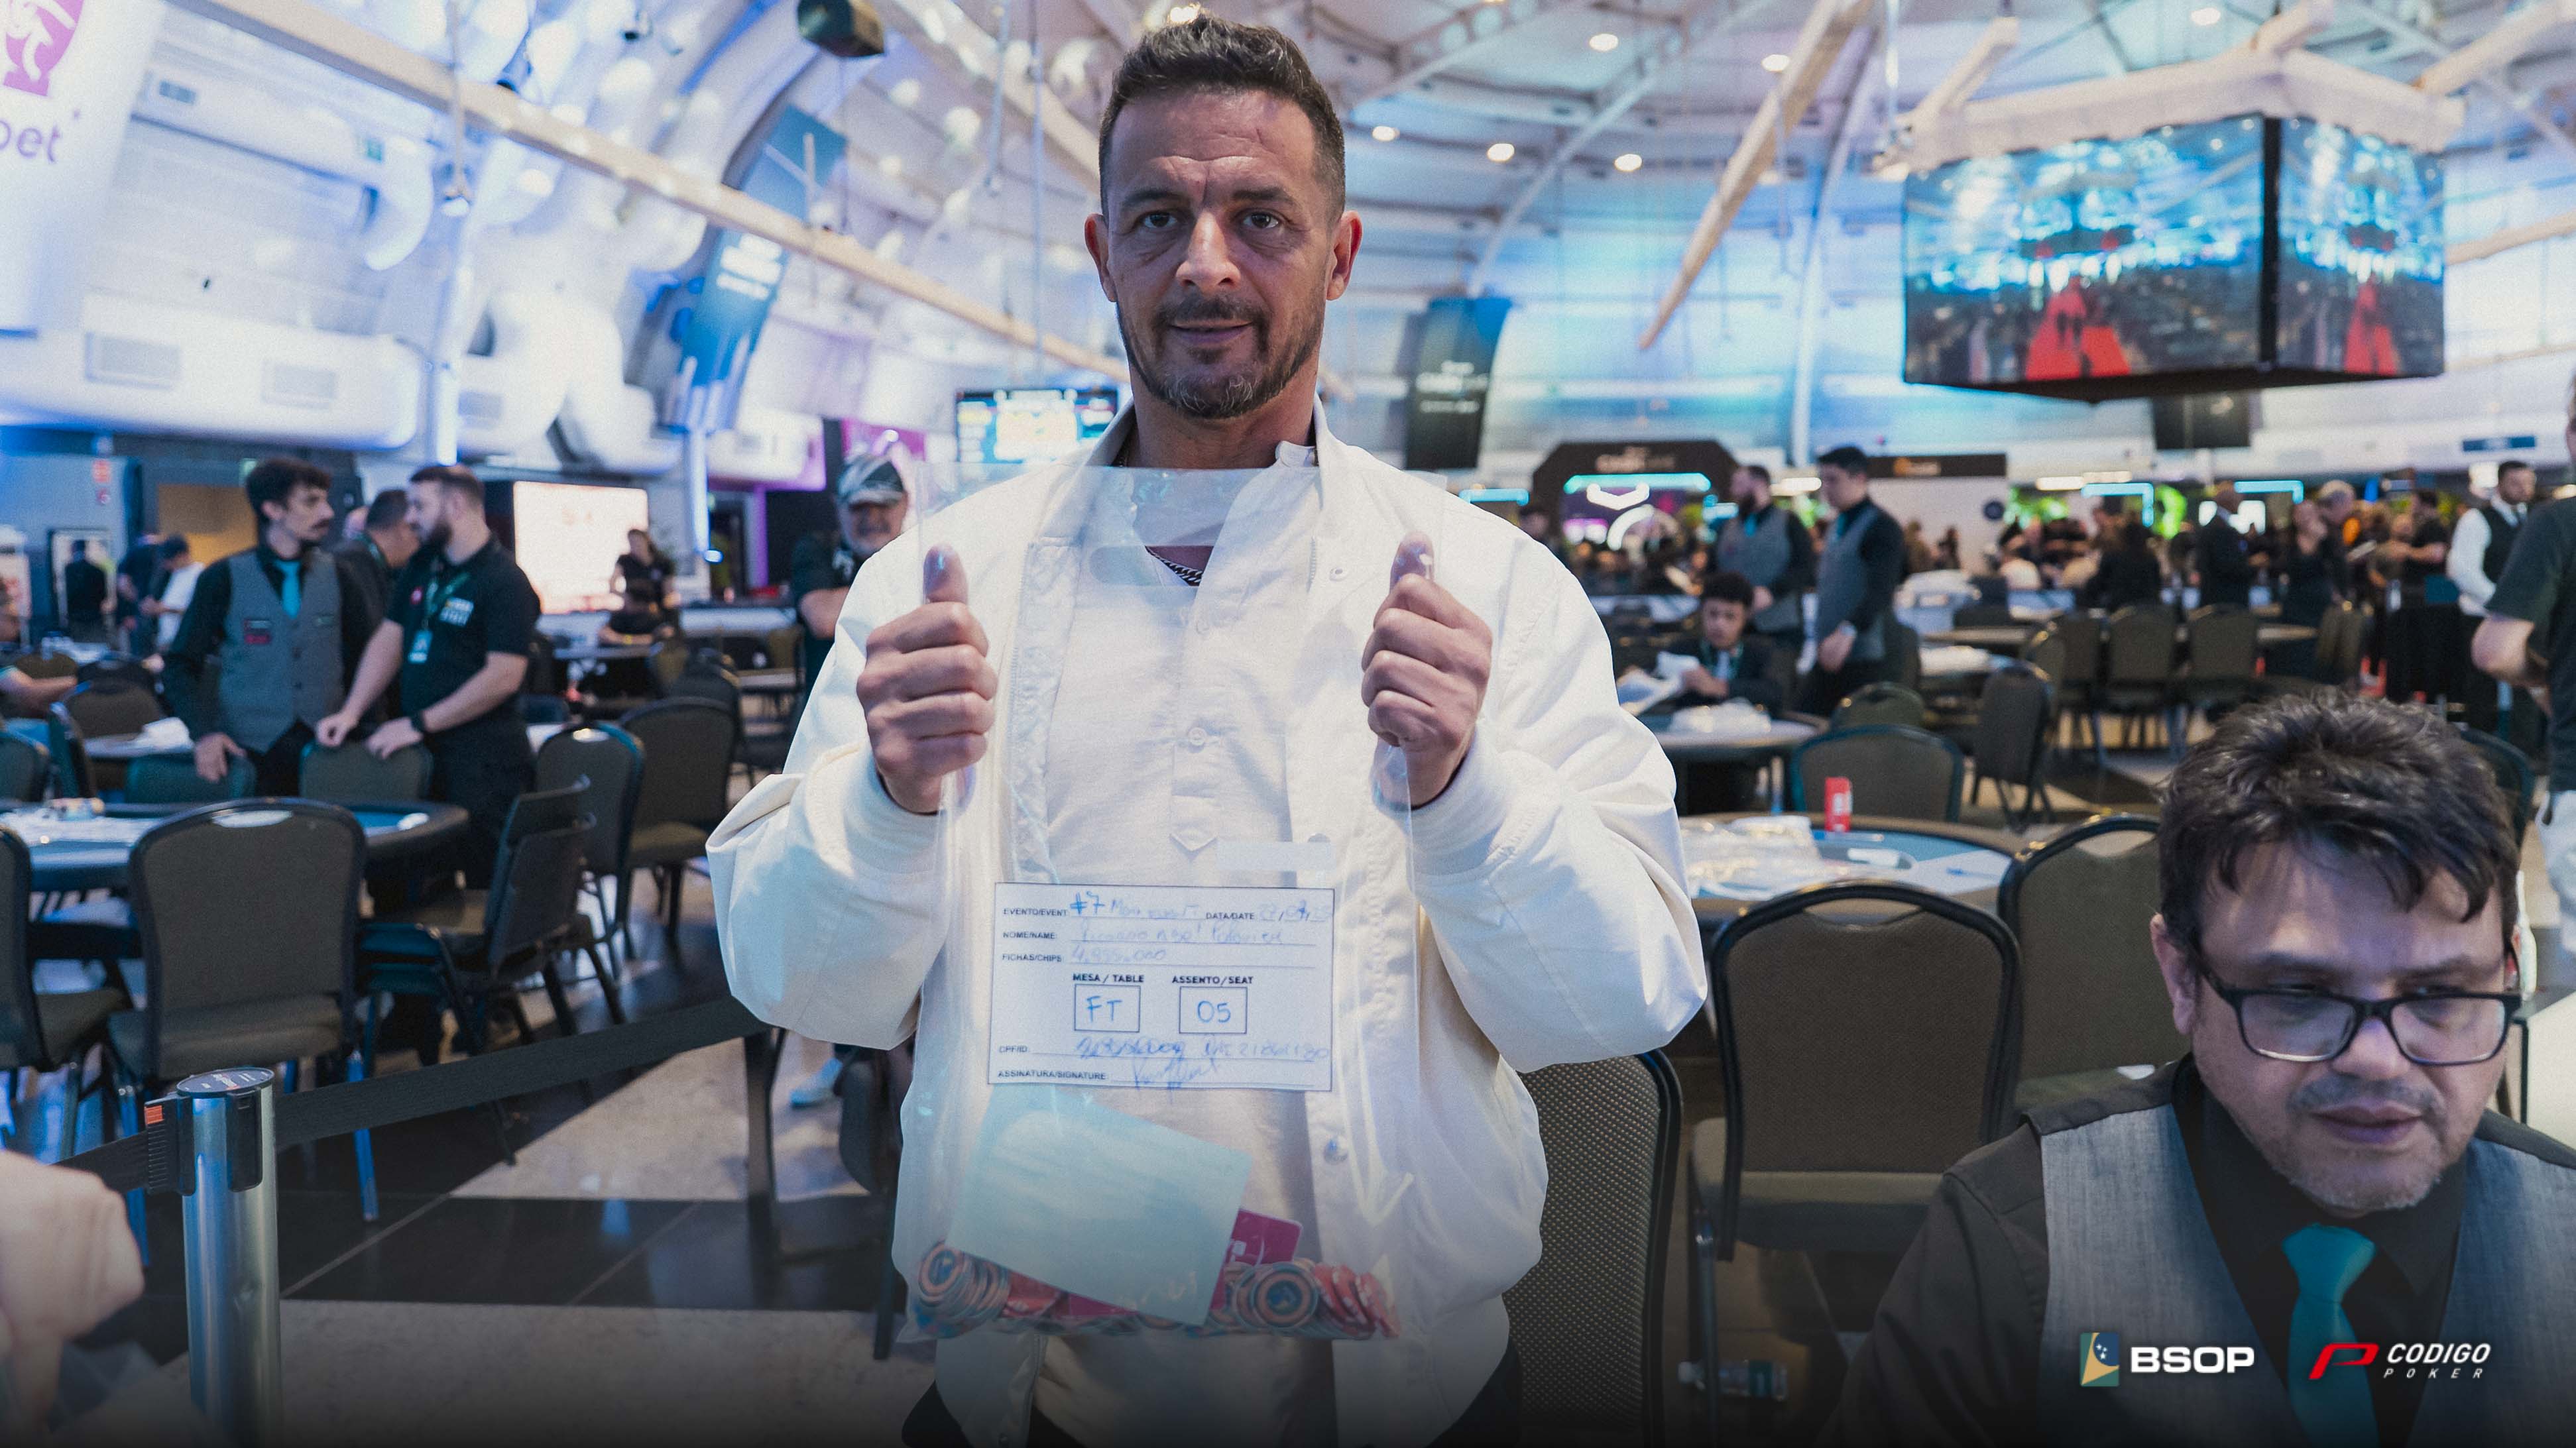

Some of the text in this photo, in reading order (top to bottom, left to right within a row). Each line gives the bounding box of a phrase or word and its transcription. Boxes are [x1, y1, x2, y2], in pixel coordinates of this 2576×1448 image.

[1073, 974, 1101, 982] MESA
[1112, 974, 1145, 983] TABLE
[1086, 995, 1123, 1023] FT
[1197, 1000, 1231, 1023] 05
